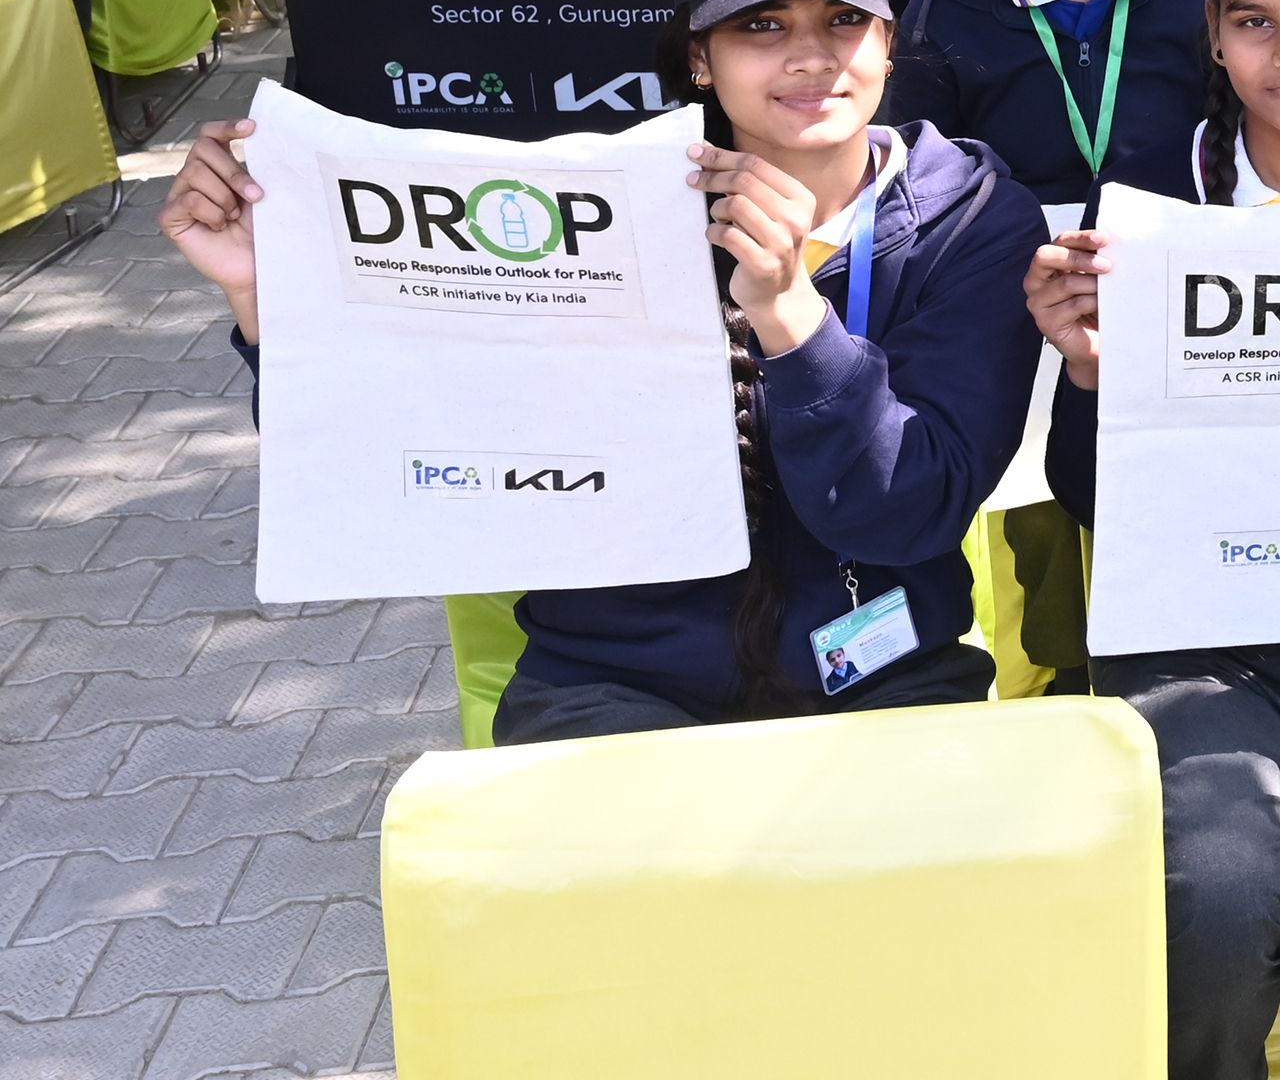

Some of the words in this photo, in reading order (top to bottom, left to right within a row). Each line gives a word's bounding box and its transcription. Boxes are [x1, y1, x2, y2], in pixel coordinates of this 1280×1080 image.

[431, 5, 503, 24] Sector
[511, 5, 539, 24] 62
[558, 5, 675, 28] Gurugram
[338, 178, 614, 262] DROP
[354, 255, 408, 273] Develop
[410, 260, 492, 277] Responsible
[495, 265, 552, 279] Outlook
[553, 268, 575, 280] for
[578, 269, 624, 282] Plastic
[399, 284, 409, 295] A
[411, 285, 440, 298] CSR
[442, 287, 502, 302] initiative
[504, 291, 522, 305] by
[525, 292, 549, 304] Kia
[552, 292, 587, 304] India
[1183, 349, 1236, 362] Develop
[1222, 372, 1232, 383] A
[1235, 371, 1262, 383] CSR
